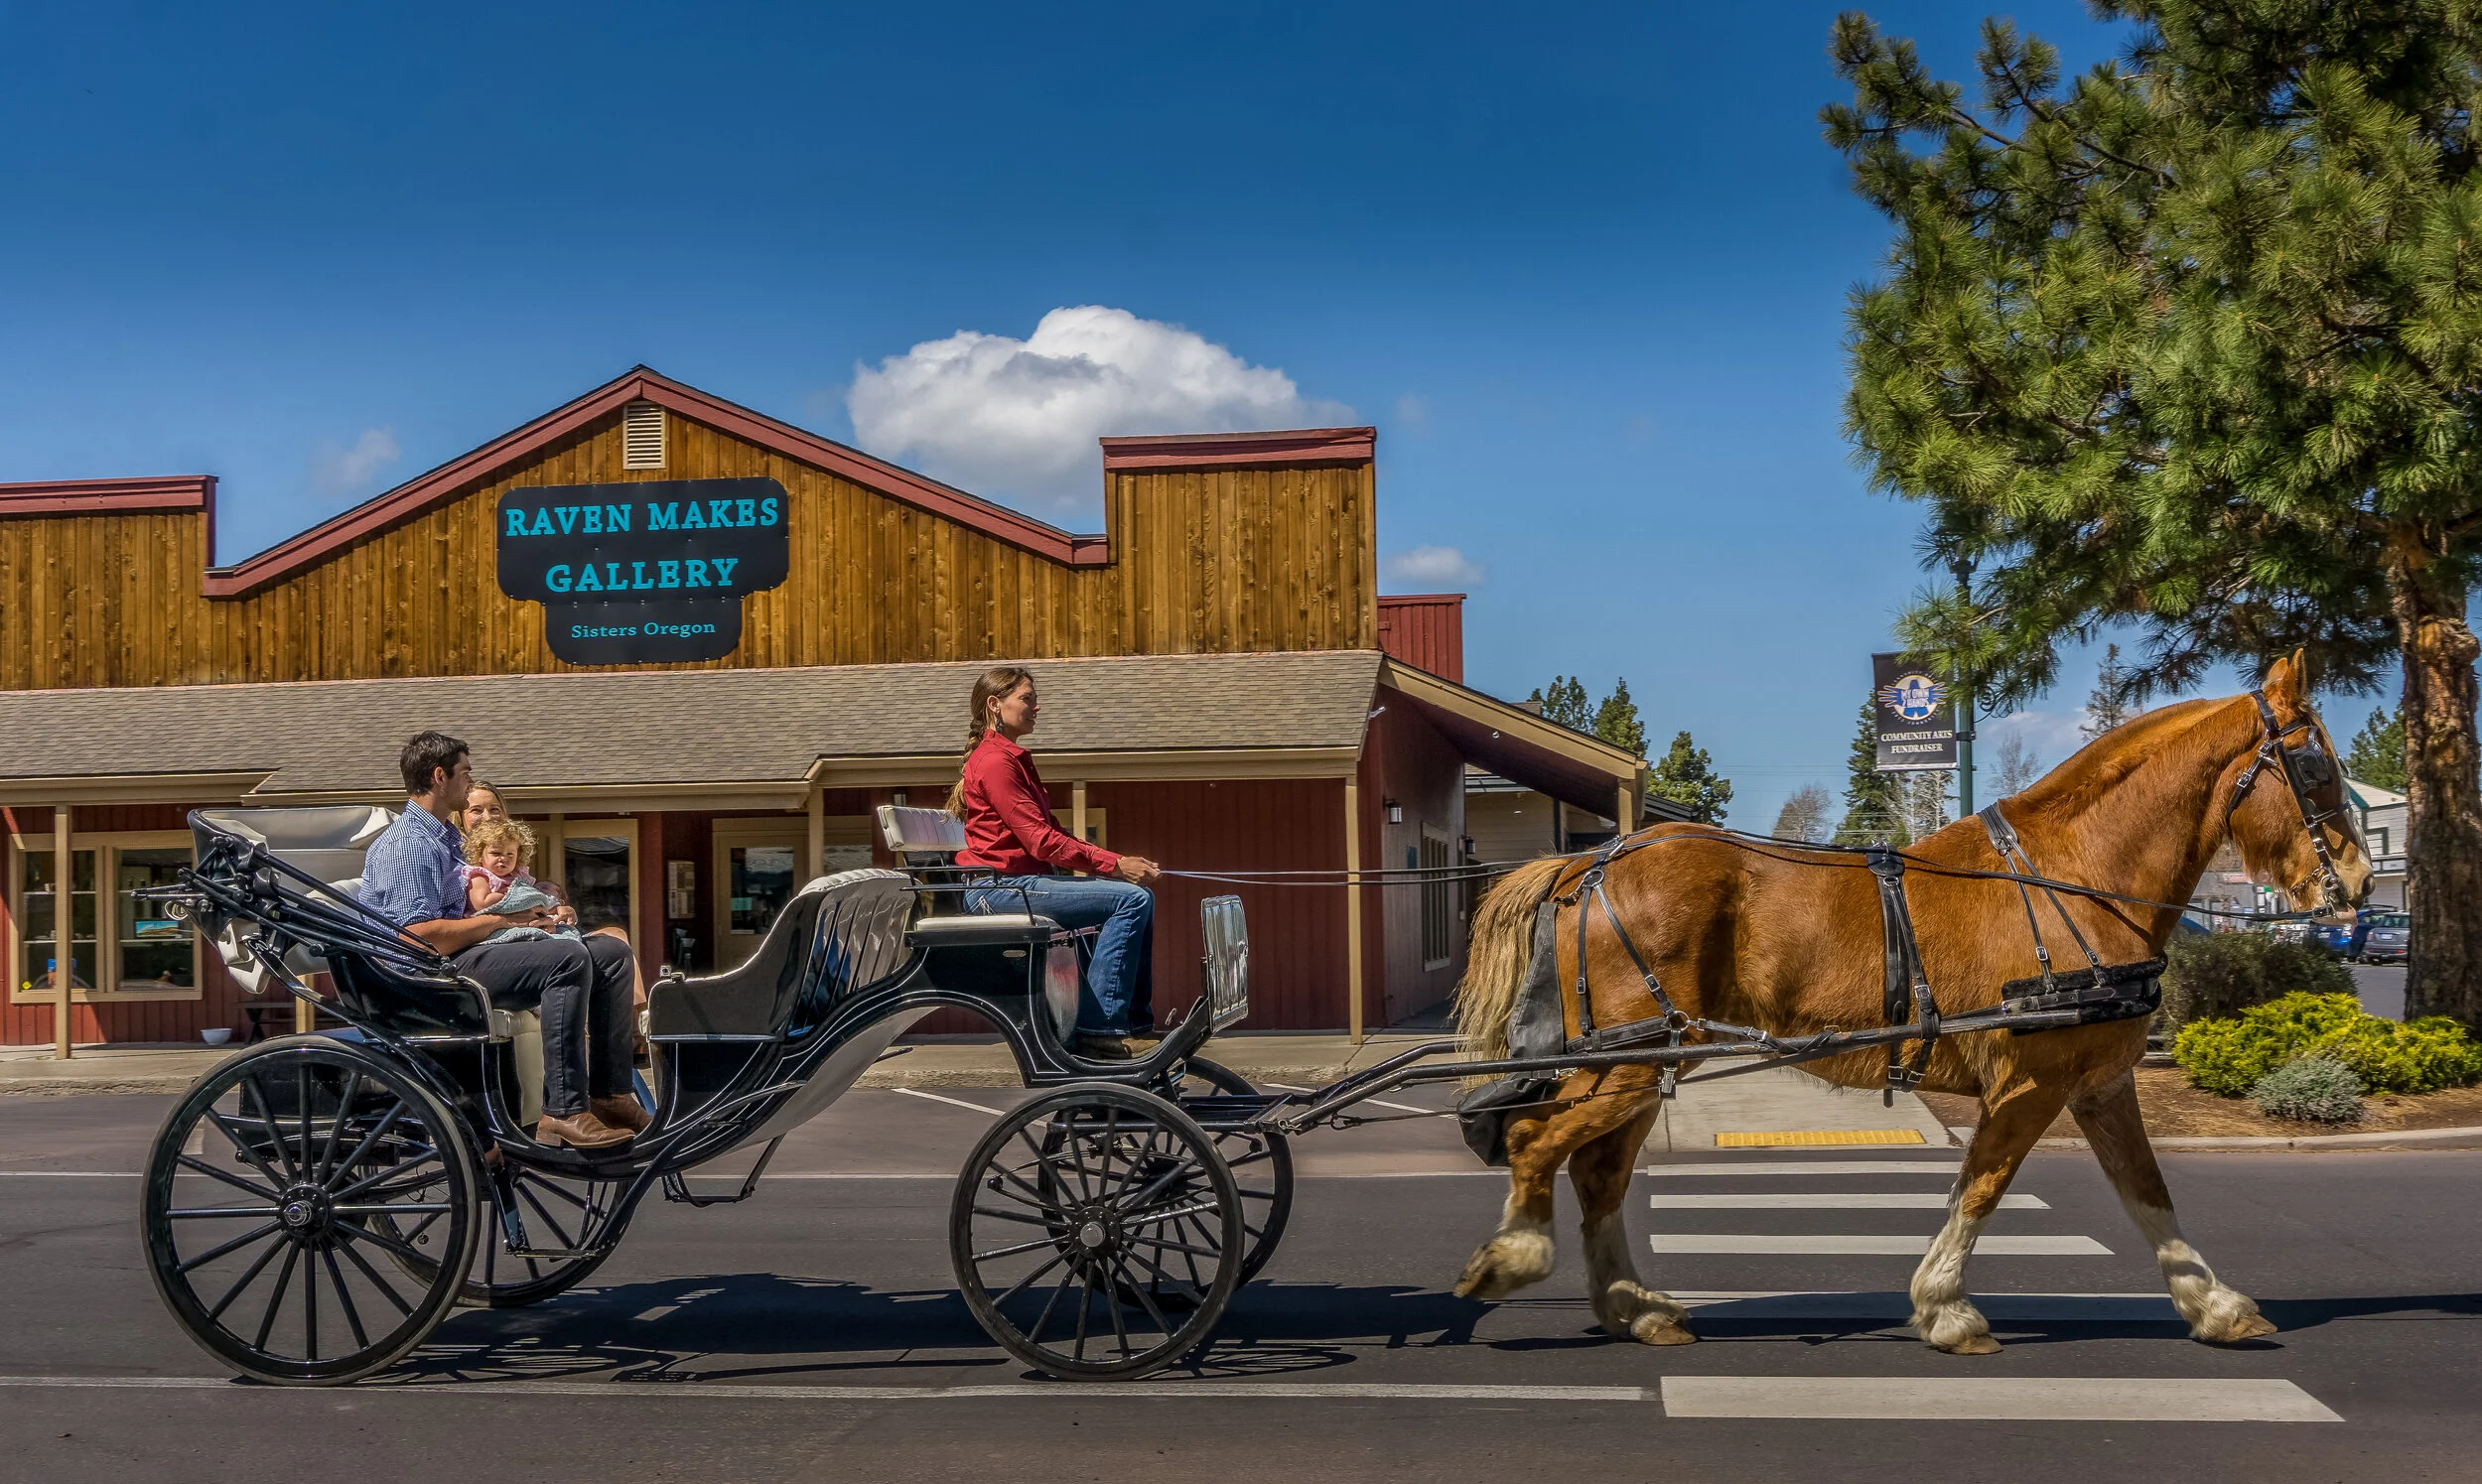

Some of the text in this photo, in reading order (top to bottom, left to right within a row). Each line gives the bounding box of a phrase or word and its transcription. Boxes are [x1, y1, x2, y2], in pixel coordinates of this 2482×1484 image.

[505, 497, 778, 537] RAVEN MAKES
[545, 558, 739, 593] GALLERY
[571, 621, 716, 638] Sisters Oregon
[1880, 730, 1953, 742] COMMUNITY ARTS
[1890, 743, 1944, 753] FUNDRAISER
